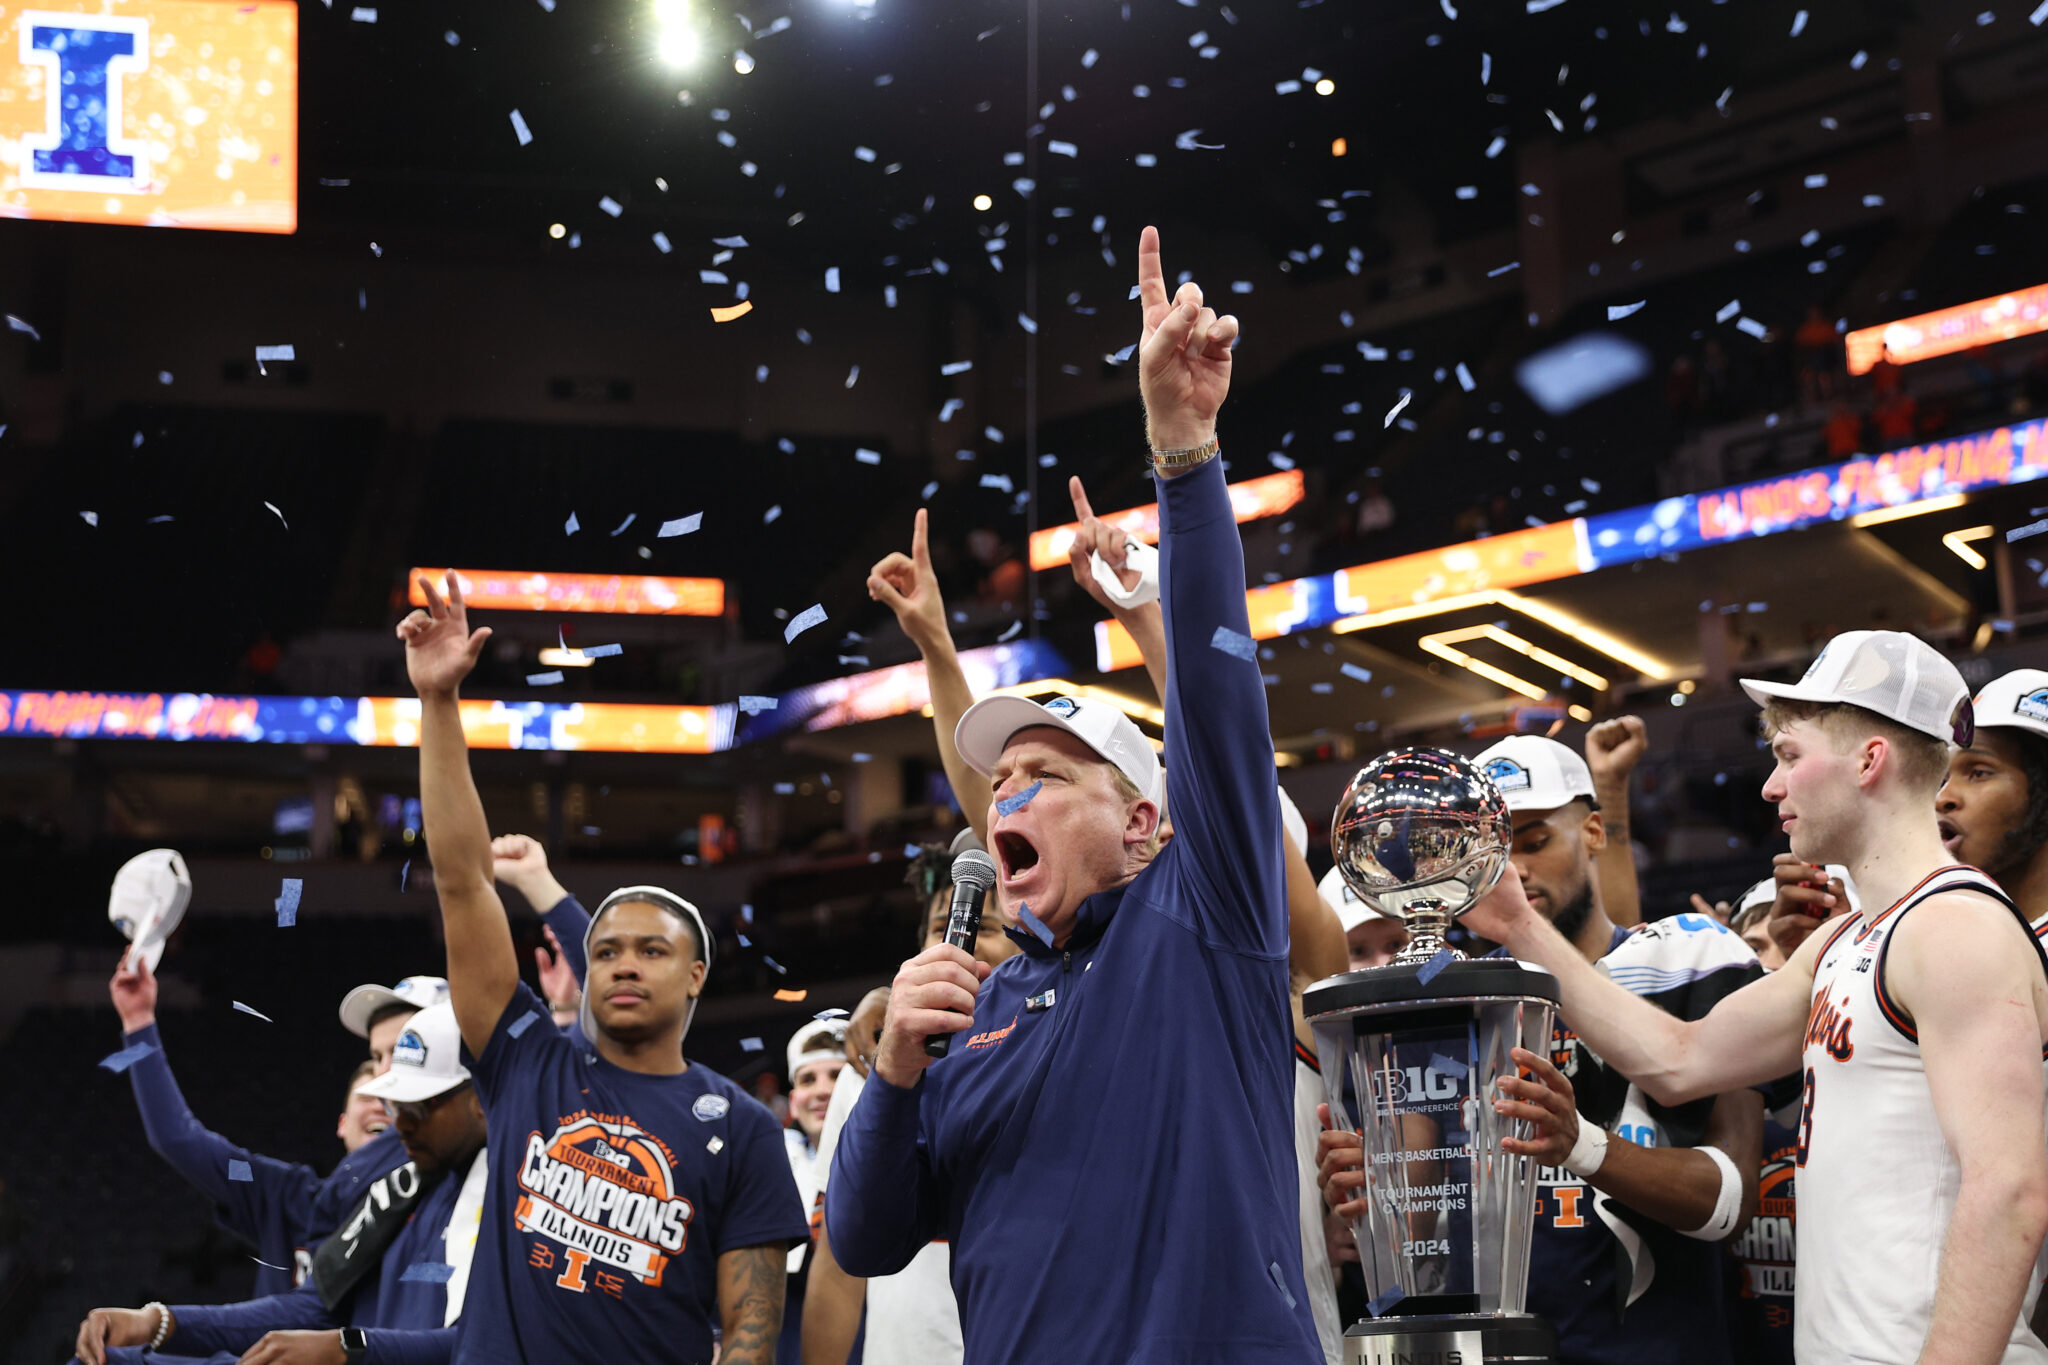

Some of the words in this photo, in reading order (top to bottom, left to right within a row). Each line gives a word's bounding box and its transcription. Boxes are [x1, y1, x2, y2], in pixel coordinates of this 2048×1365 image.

[21, 10, 149, 194] I
[1405, 1103, 1459, 1114] CONFERENCE
[1371, 1151, 1403, 1164] MEN'S
[1405, 1146, 1472, 1162] BASKETBALL
[559, 1145, 658, 1197] TOURNAMENT
[519, 1132, 693, 1252] CHAMPIONS
[1378, 1183, 1468, 1200] TOURNAMENT
[1383, 1198, 1466, 1215] CHAMPIONS
[539, 1207, 632, 1264] ILLINOIS
[1402, 1239, 1450, 1257] 2024
